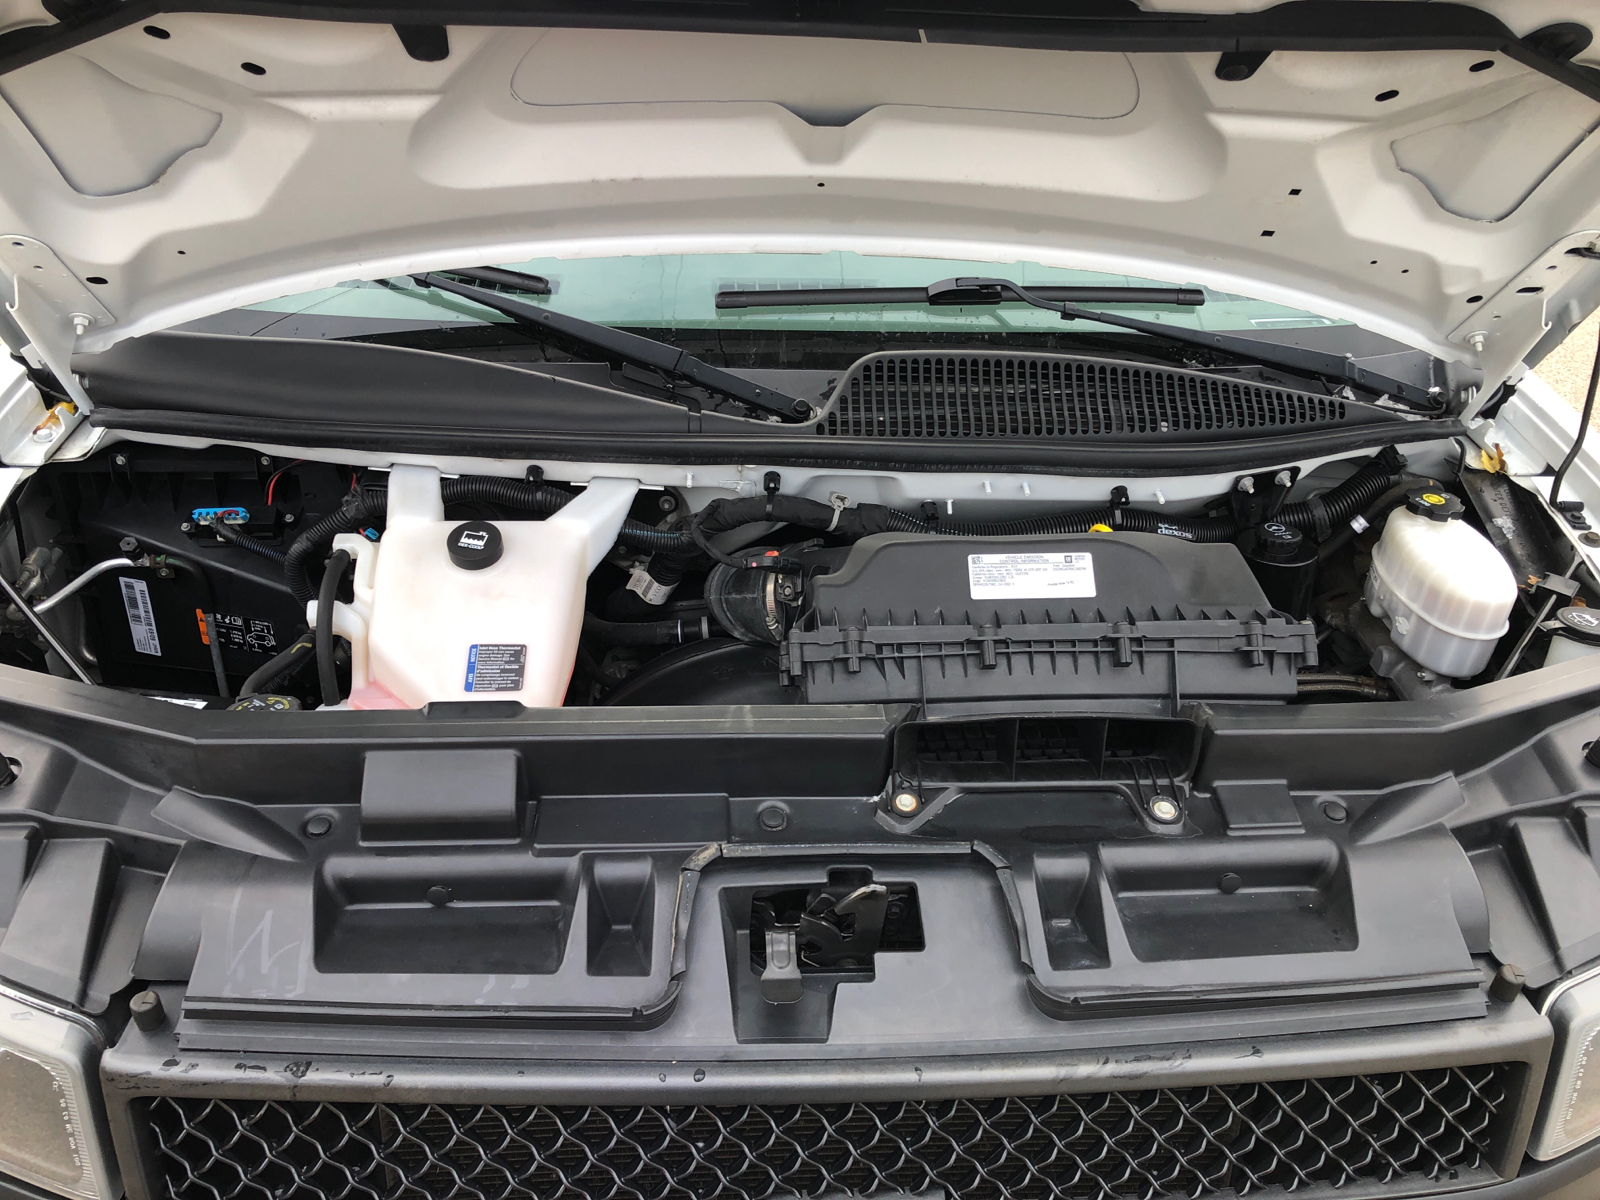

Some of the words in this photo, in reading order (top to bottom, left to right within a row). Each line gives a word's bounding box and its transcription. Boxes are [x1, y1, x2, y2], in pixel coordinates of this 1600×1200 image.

[1157, 527, 1193, 539] dexos
[62, 1111, 69, 1121] 03
[68, 1136, 76, 1150] VOR
[72, 1154, 81, 1166] DOT
